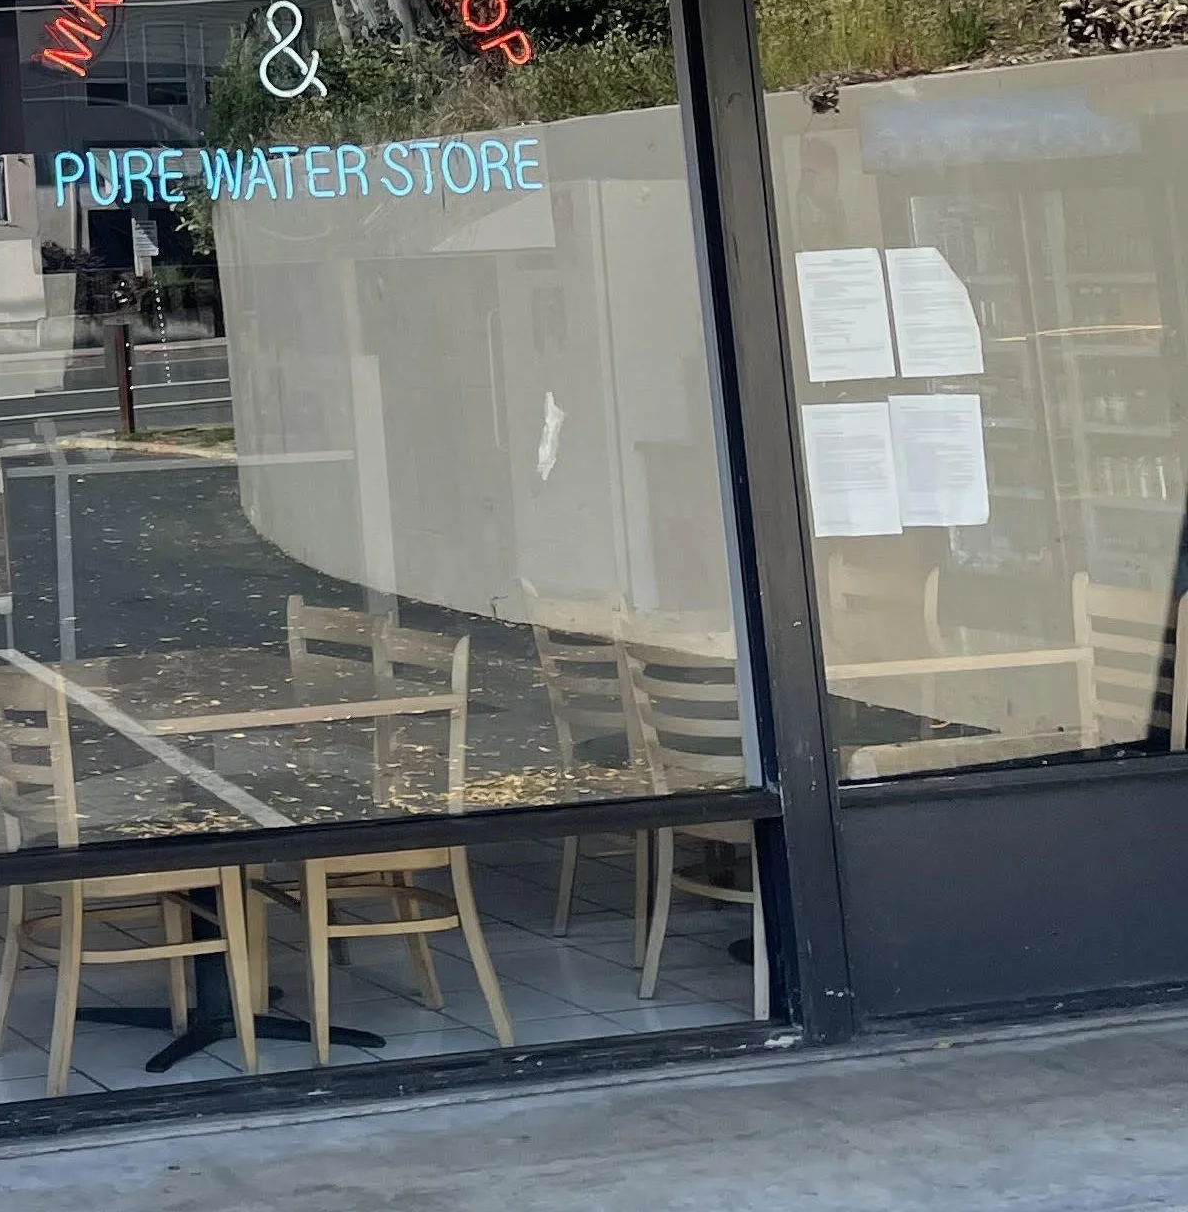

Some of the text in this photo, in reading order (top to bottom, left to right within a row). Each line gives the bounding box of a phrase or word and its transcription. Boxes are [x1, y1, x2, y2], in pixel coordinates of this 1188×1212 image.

[260, 1, 327, 97] &
[55, 138, 543, 206] PURE WATER STORE
